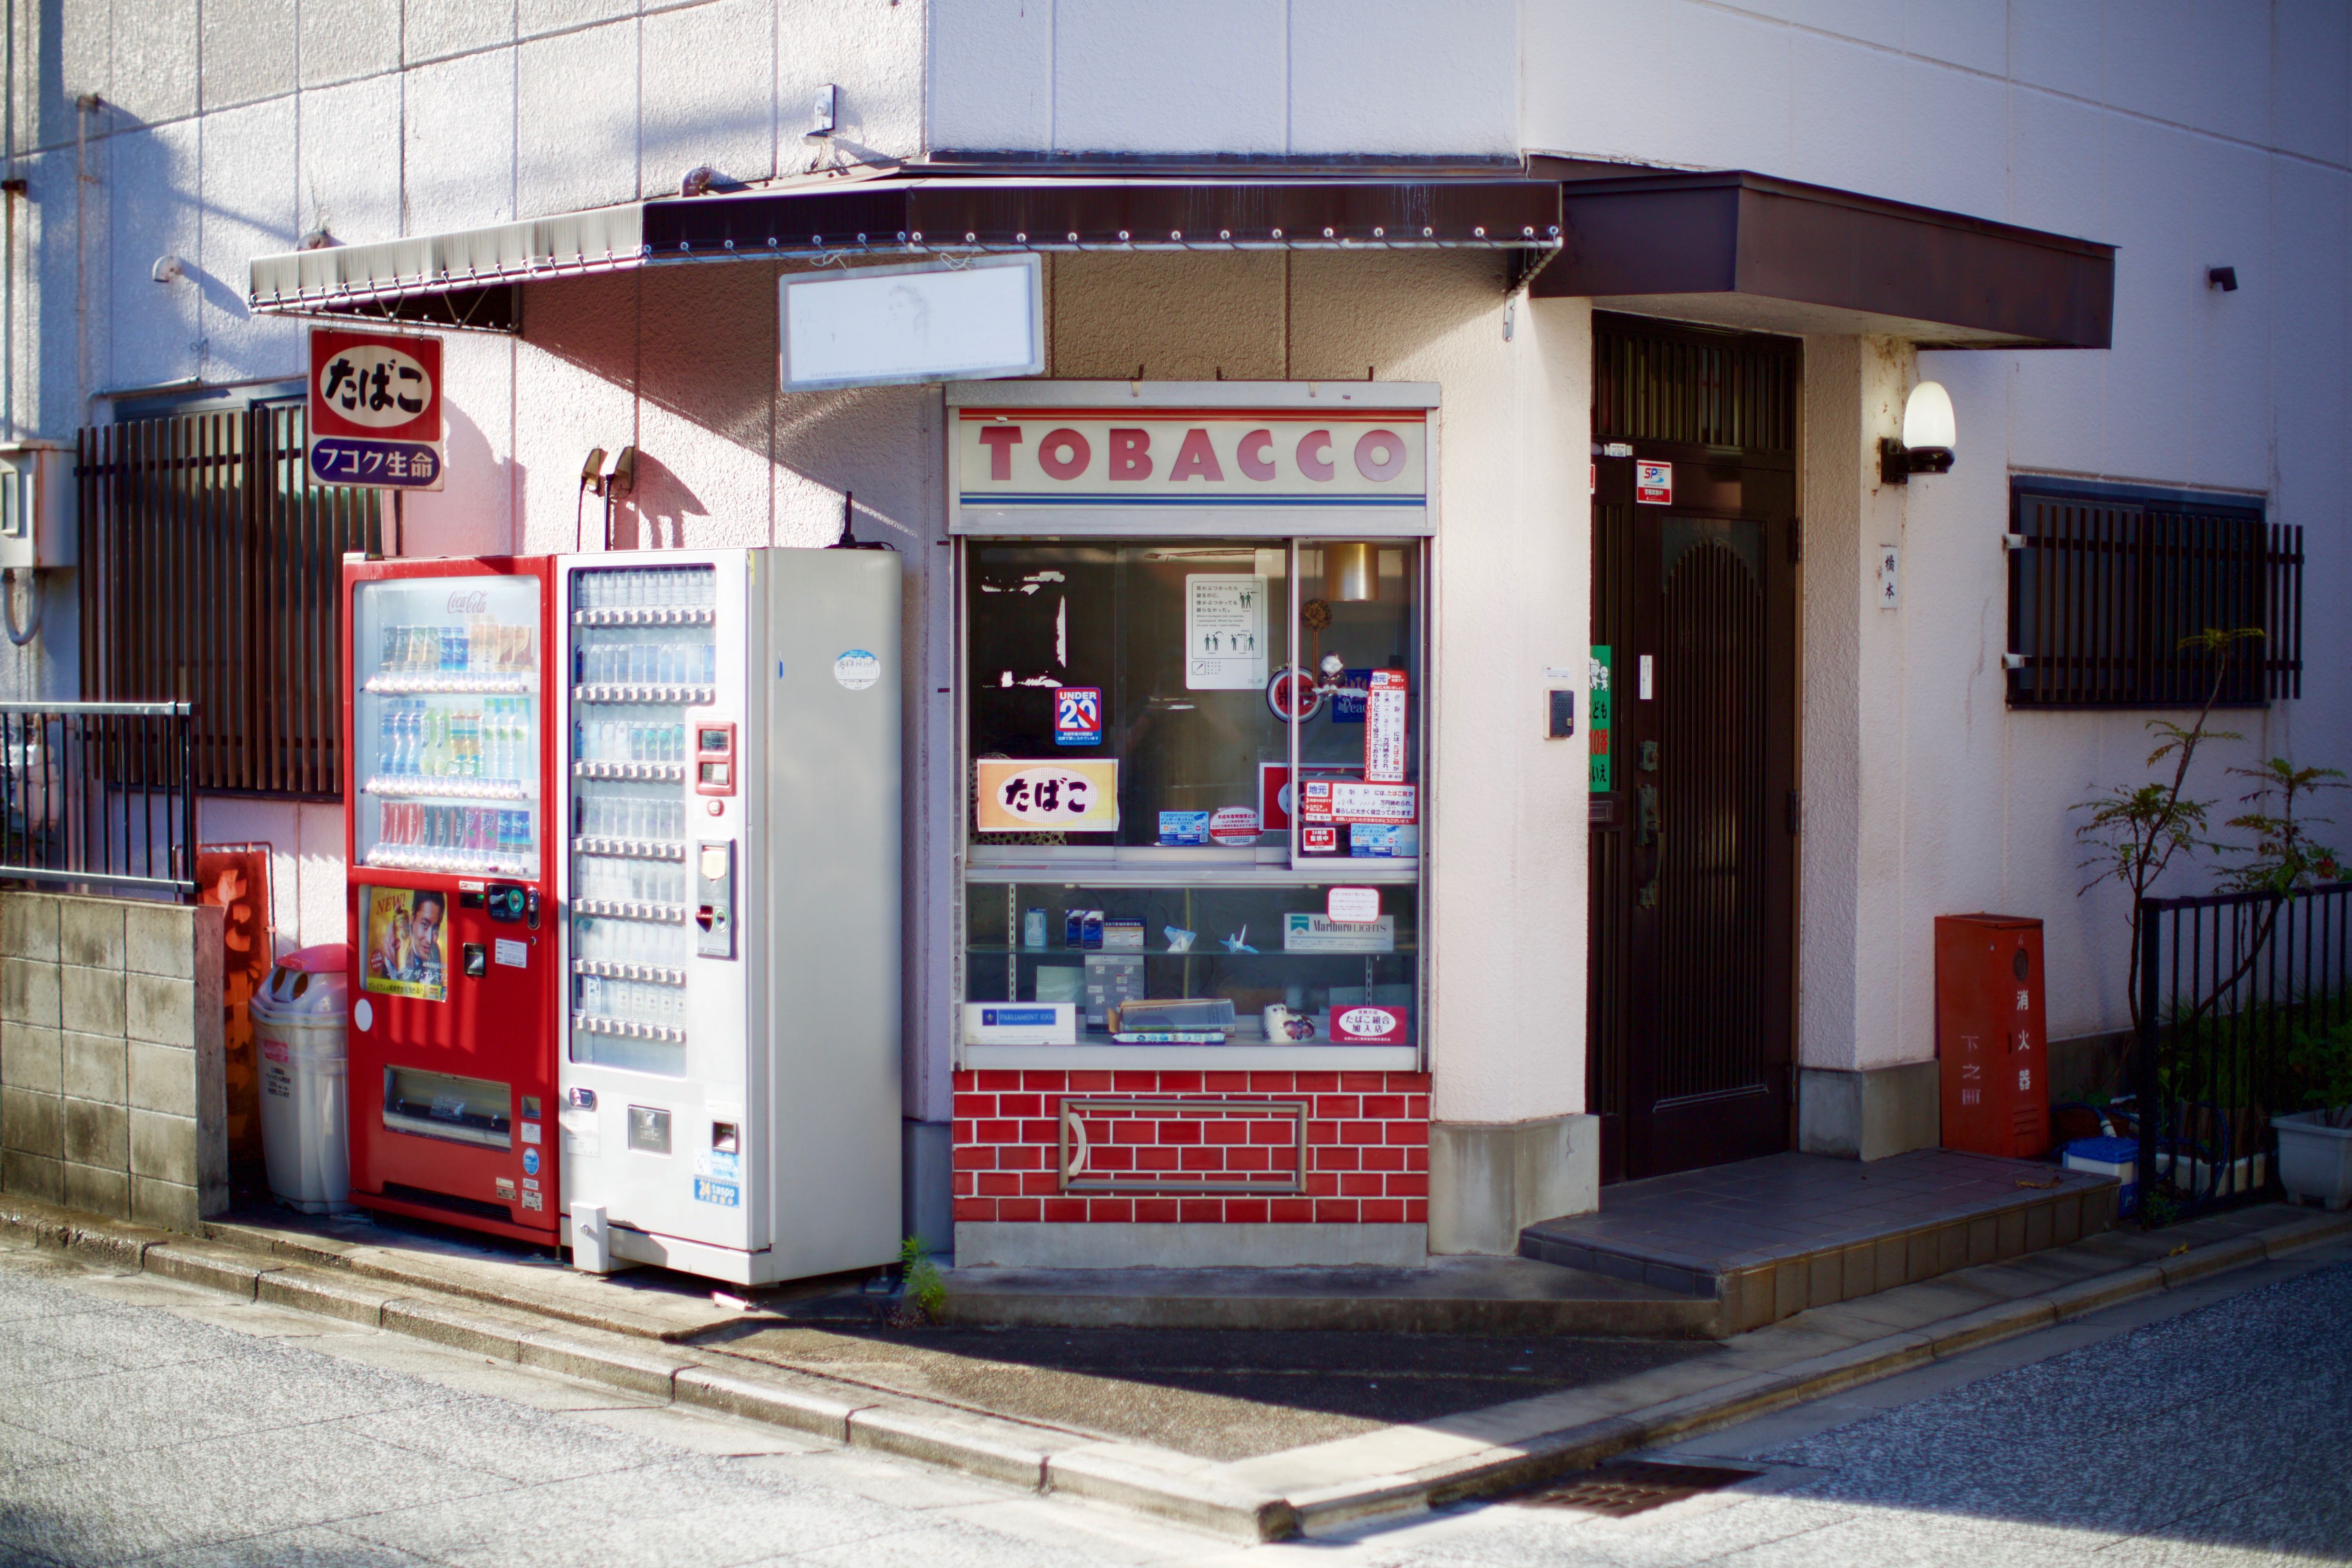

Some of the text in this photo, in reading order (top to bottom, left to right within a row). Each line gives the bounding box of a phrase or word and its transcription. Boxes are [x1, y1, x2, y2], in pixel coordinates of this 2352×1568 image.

[325, 358, 423, 413] たばこ
[319, 448, 434, 478] フコク生命
[979, 426, 1407, 482] TOBACCO
[1885, 555, 1895, 600] 橋本
[447, 590, 488, 614] Coca-Cola
[1060, 699, 1096, 728] 20
[1342, 698, 1367, 714] Peac
[1589, 700, 1607, 719] ども
[1589, 764, 1606, 782] いえ
[1006, 777, 1087, 813] たばこ
[1308, 785, 1326, 794] 地元
[1335, 808, 1412, 816] 暮らしに大きく役立っております。
[376, 892, 406, 915] NEW!
[1313, 920, 1387, 933] Marlboro LIGHTS
[1346, 1015, 1390, 1024] たばこ組合
[1353, 1024, 1383, 1033] 加入店
[2017, 990, 2031, 1091] 消火器
[699, 1181, 734, 1198] 24 taspo
